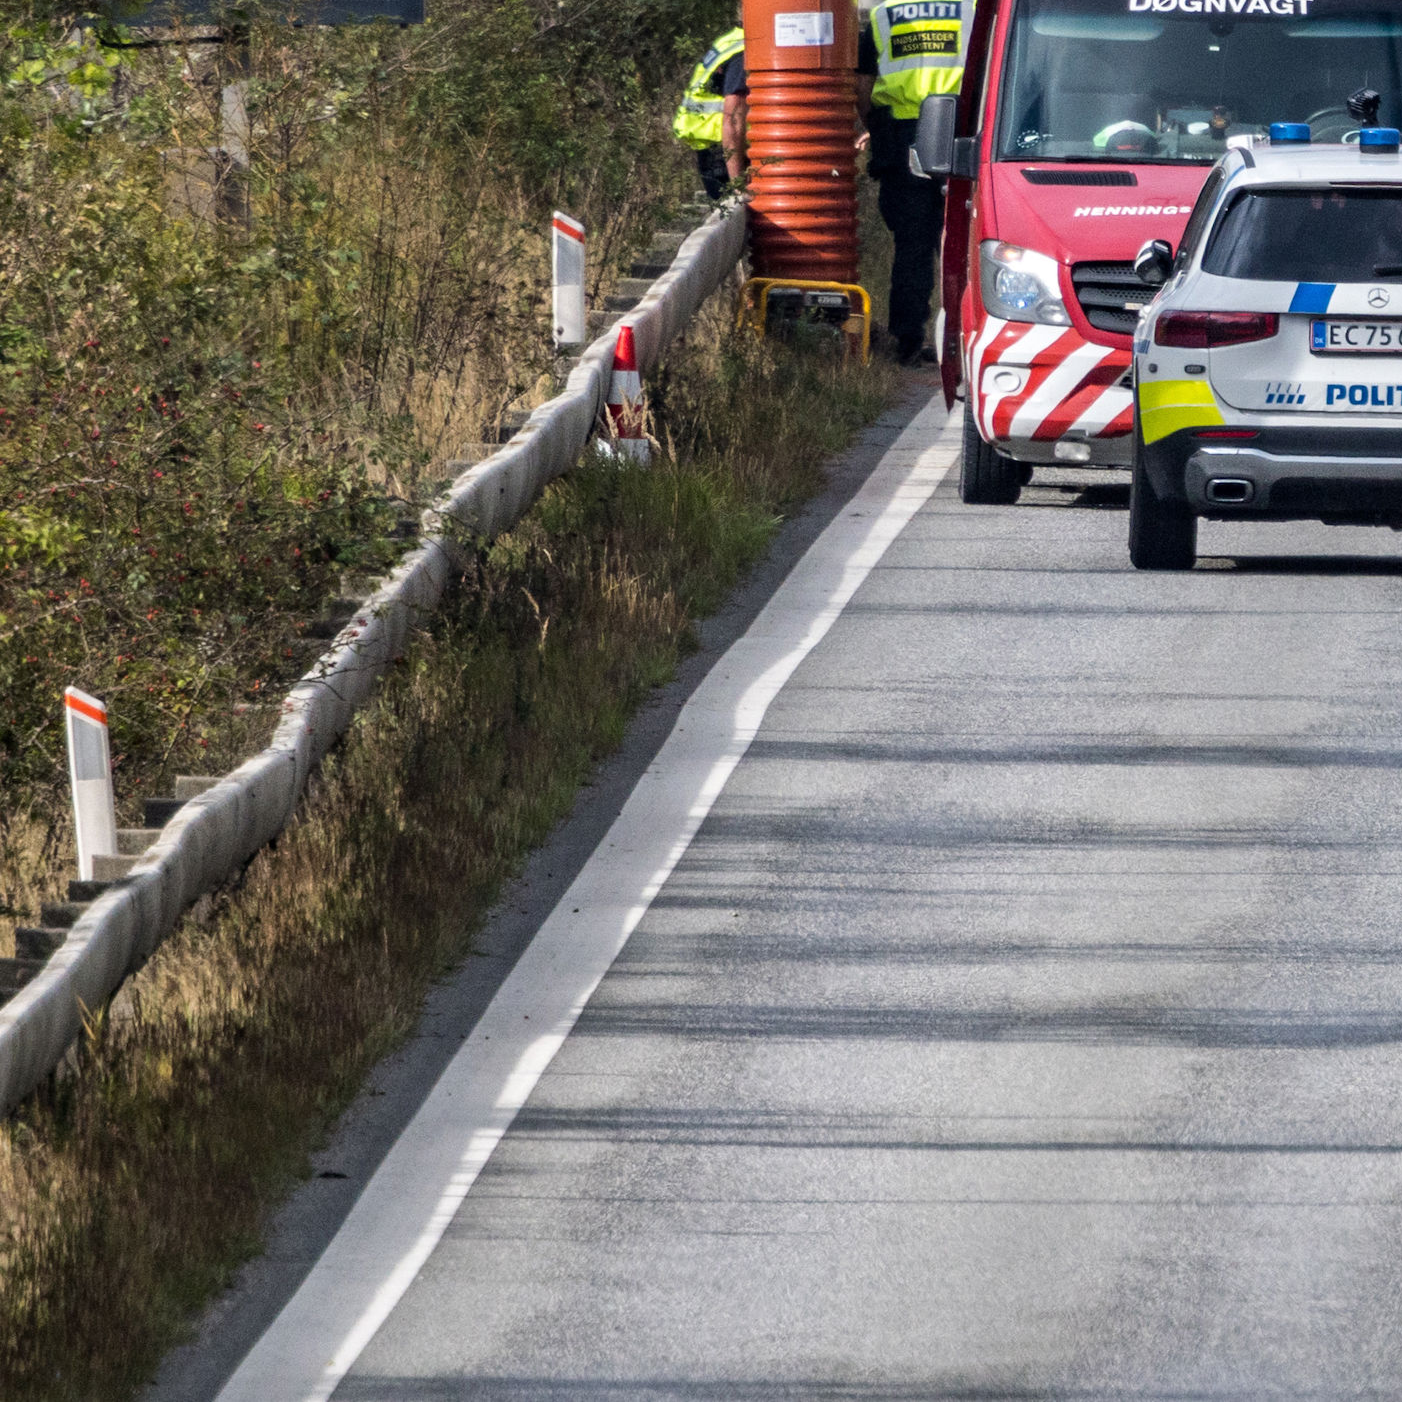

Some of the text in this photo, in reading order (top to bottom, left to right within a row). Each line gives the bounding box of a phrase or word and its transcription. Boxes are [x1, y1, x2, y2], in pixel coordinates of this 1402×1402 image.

[891, 1, 957, 23] POLITI
[1330, 325, 1359, 345] EC
[1365, 326, 1392, 346] 75
